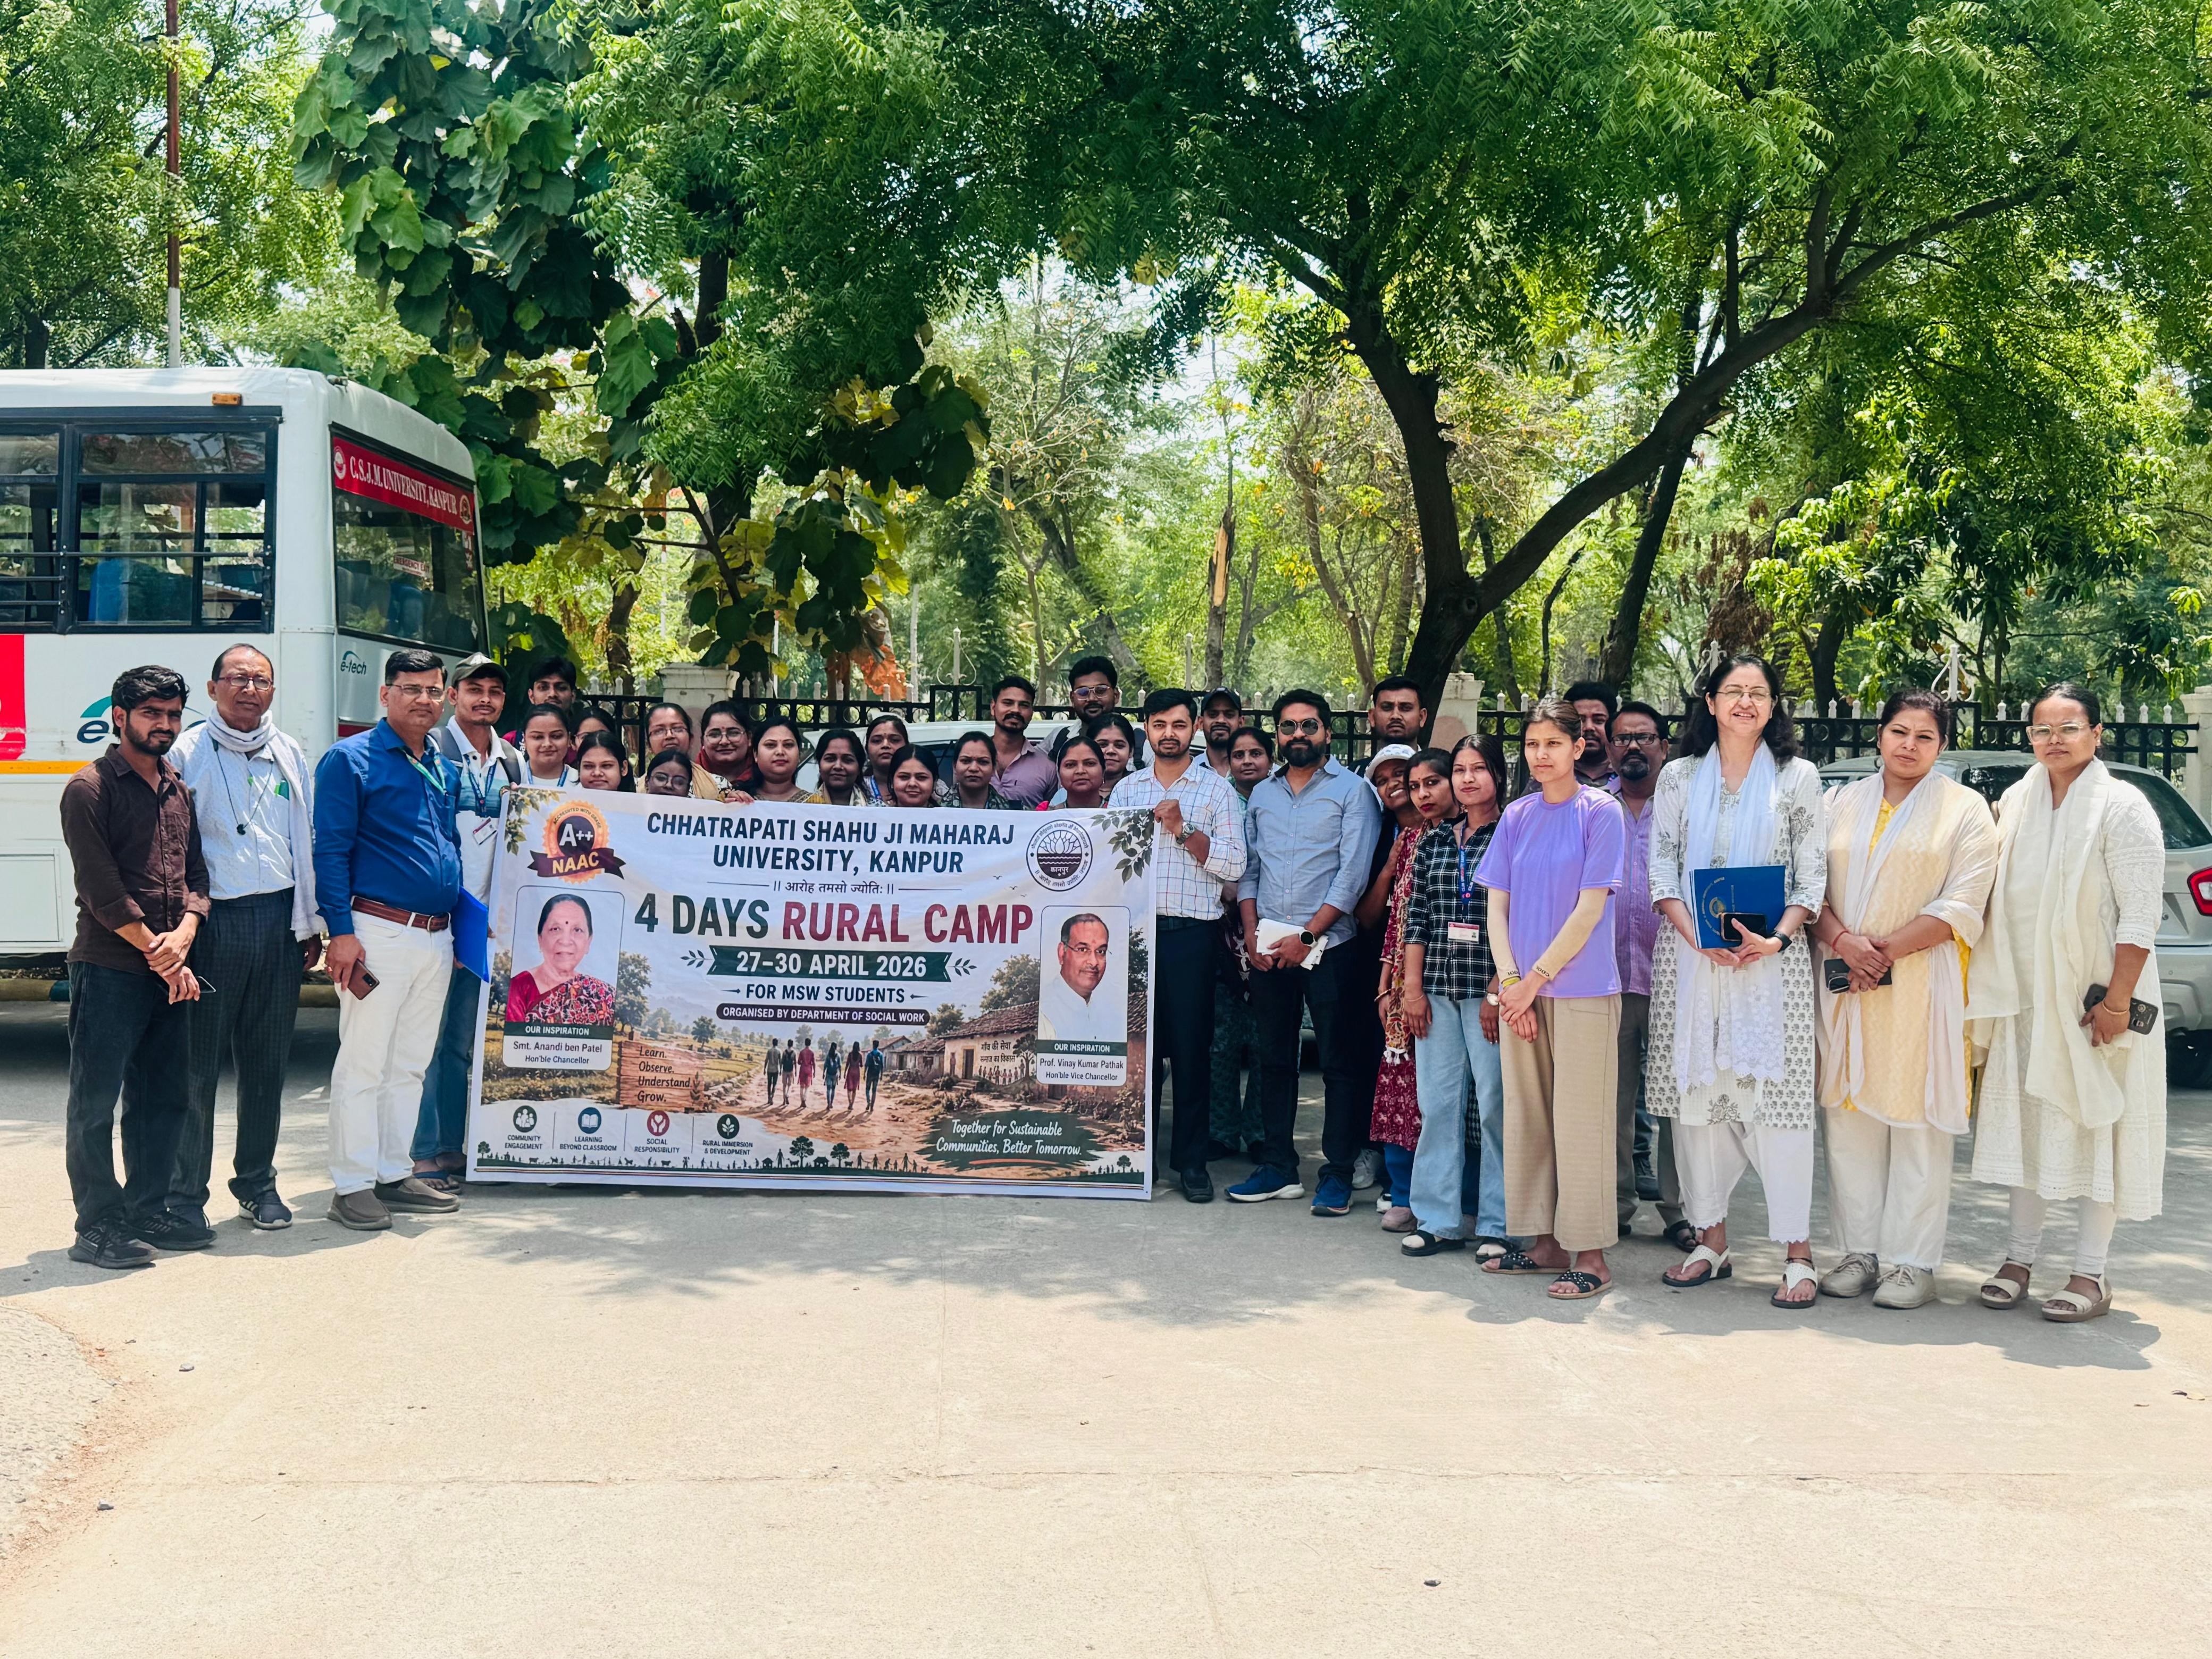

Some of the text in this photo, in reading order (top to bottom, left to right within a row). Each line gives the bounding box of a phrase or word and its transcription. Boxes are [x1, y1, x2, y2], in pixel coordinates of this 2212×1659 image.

[429, 484, 457, 515] KANPUR
[340, 659, 366, 675] e-tech
[559, 824, 593, 847] A++
[648, 812, 795, 840] CHHATRAPATI
[803, 820, 877, 843] SHAHU
[884, 823, 903, 843] JI
[910, 824, 1014, 844] MAHARAJ
[552, 851, 599, 874] NAAC
[713, 845, 963, 876] UNIVERSITY, KANPUR
[785, 879, 814, 894] आरोह
[819, 881, 847, 893] तमसो
[634, 893, 1033, 944] 4 DAYS RURAL CAMP
[809, 954, 868, 976] APRIL
[876, 956, 926, 977] 2026
[747, 984, 904, 1002] FOR MSW STUDENTS
[723, 1007, 925, 1022] ORGANISED BY DEPARTMENT OF SOCIAL WORK
[543, 1026, 589, 1035] INSPIRATION
[514, 1042, 602, 1052] Smt. Anandi ben Patel
[639, 1046, 667, 1058] Learn.
[992, 1041, 999, 1051] की
[1000, 1040, 1011, 1050] सेवा
[1054, 1043, 1110, 1052] OUR INSPIRATION
[1000, 1054, 1015, 1062] विकास
[1040, 1058, 1123, 1069] Prof. Vinay Kumar Pathak
[639, 1061, 674, 1073] Observe.
[638, 1091, 667, 1102] Grow.
[952, 1119, 1062, 1138] Together for Sustainable
[936, 1137, 1082, 1155] Communities, Better Tomorrow.
